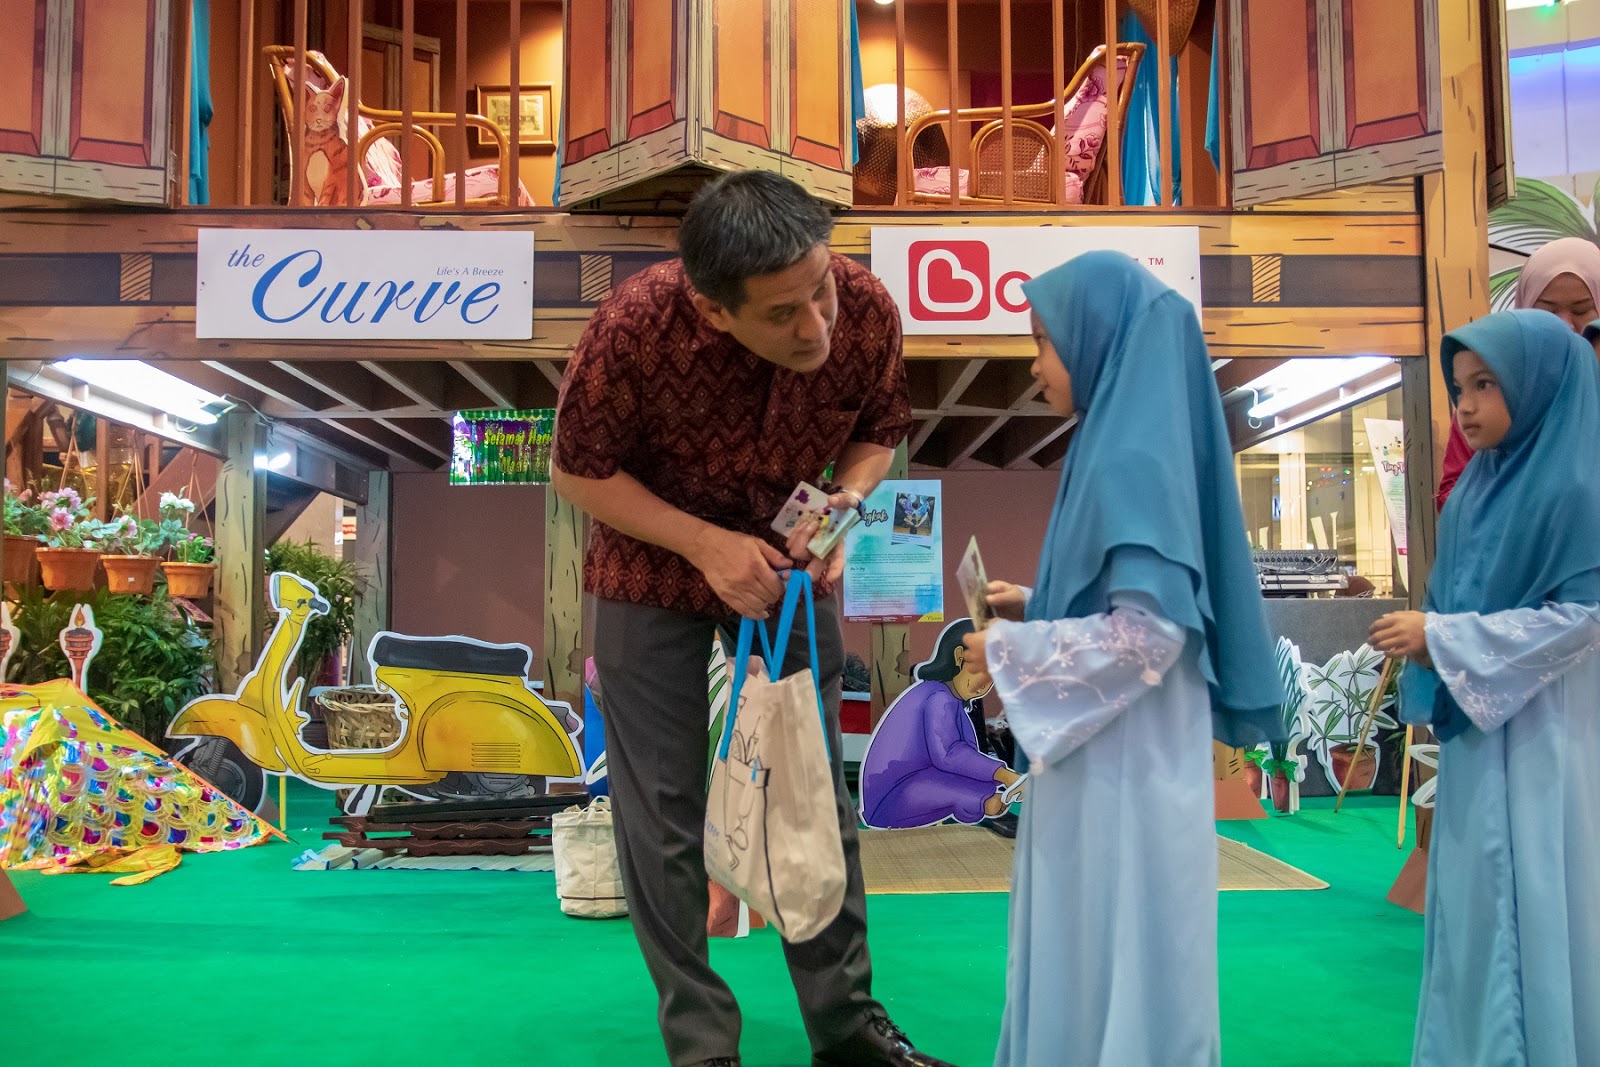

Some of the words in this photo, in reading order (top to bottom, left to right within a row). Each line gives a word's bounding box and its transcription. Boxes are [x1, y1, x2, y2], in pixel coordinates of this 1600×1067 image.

[228, 244, 265, 267] the
[252, 249, 501, 324] Curve
[436, 267, 460, 276] Life's
[462, 267, 469, 276] A
[472, 267, 504, 276] Breeze
